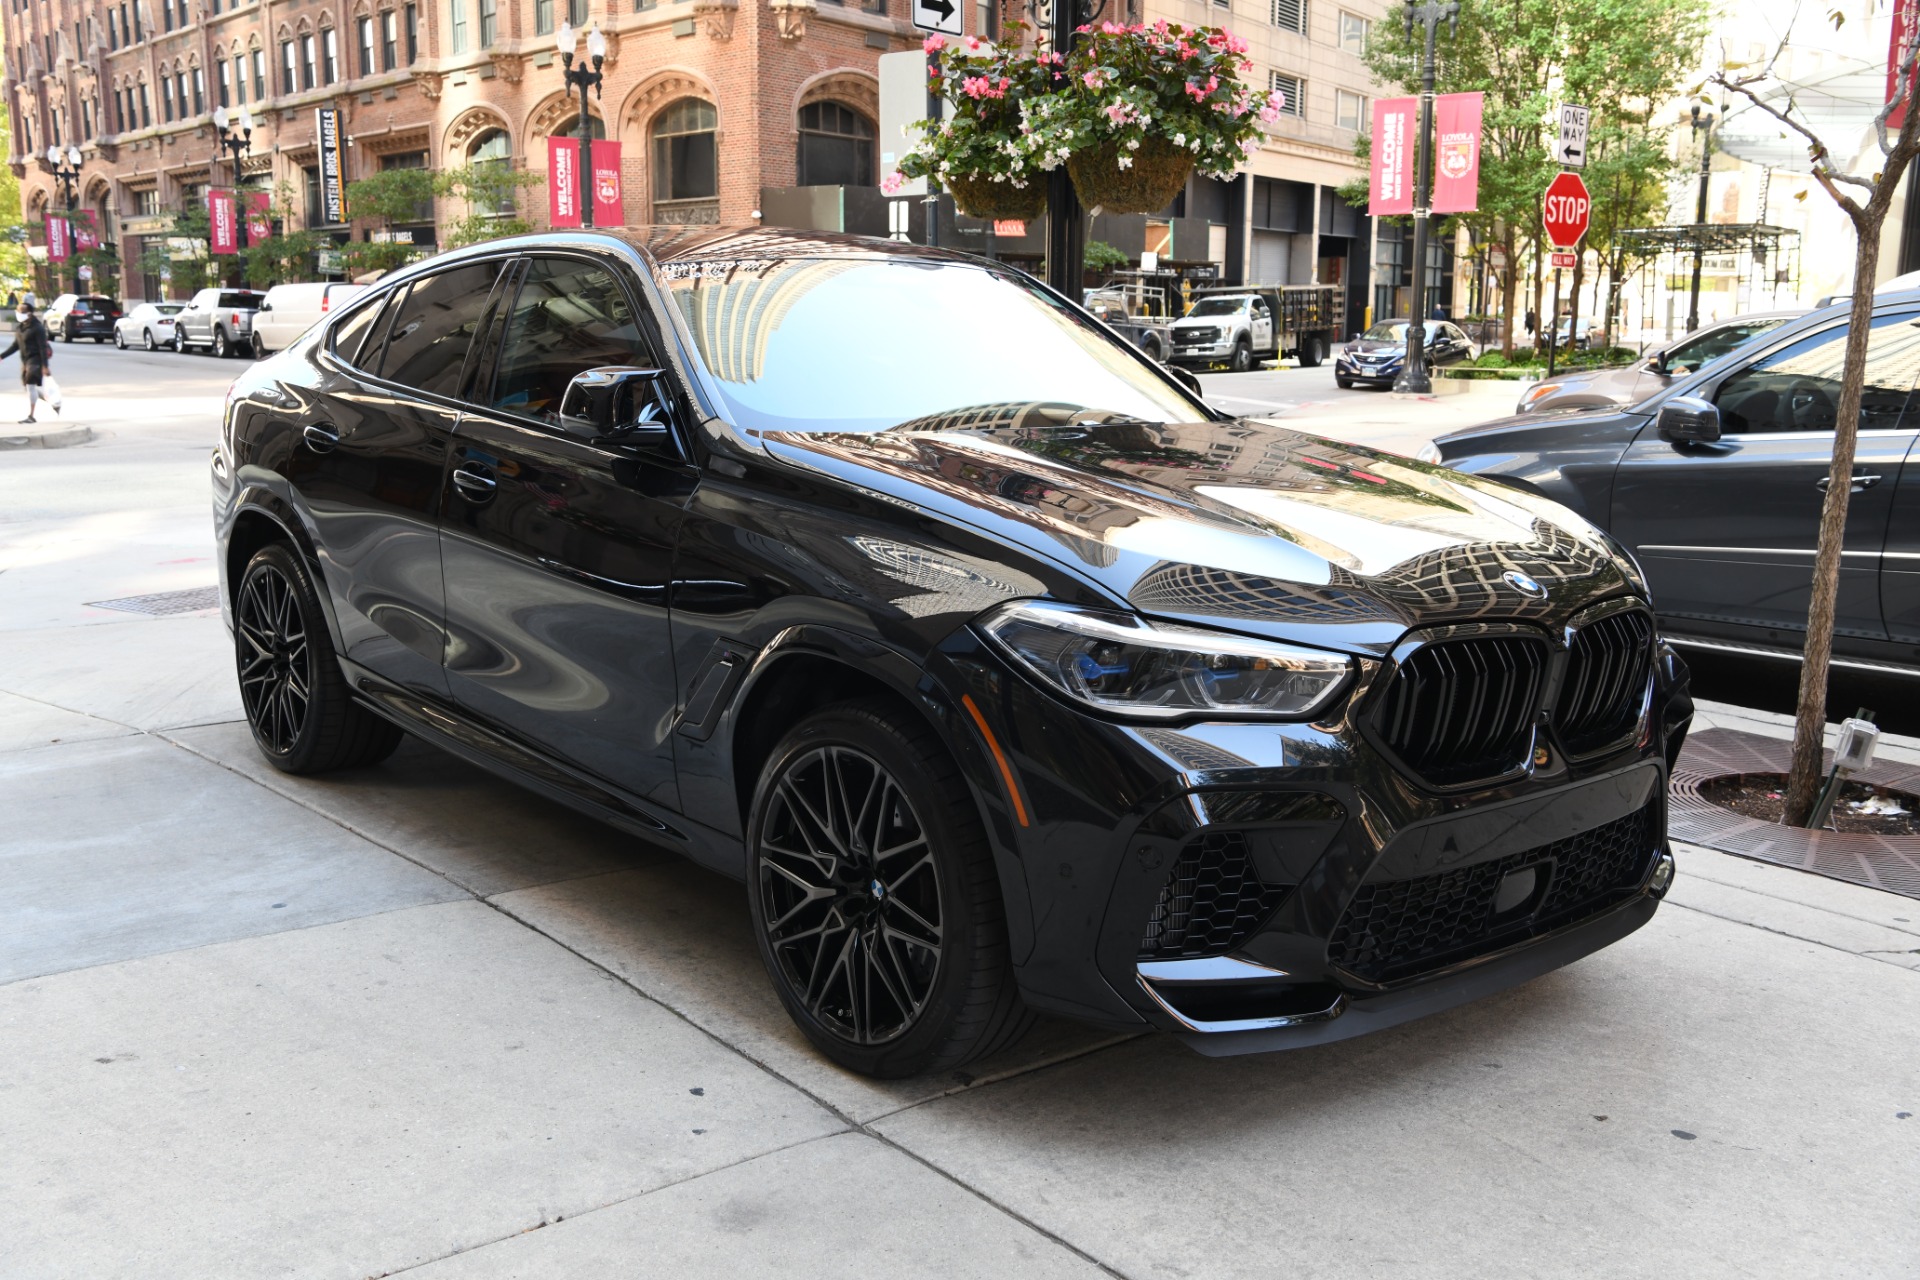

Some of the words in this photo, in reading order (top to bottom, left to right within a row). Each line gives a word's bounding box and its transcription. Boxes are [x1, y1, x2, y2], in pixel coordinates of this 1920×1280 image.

[323, 111, 336, 148] BAGELS
[1564, 110, 1585, 126] ONE
[1442, 133, 1474, 141] LOYOLA
[1563, 126, 1585, 142] WAY
[1380, 112, 1397, 201] WELCOME
[555, 147, 570, 216] WELCOME
[215, 198, 225, 246] WELCOME
[1546, 195, 1587, 225] STOP
[1552, 255, 1562, 265] ALL
[1563, 256, 1574, 266] WAY
